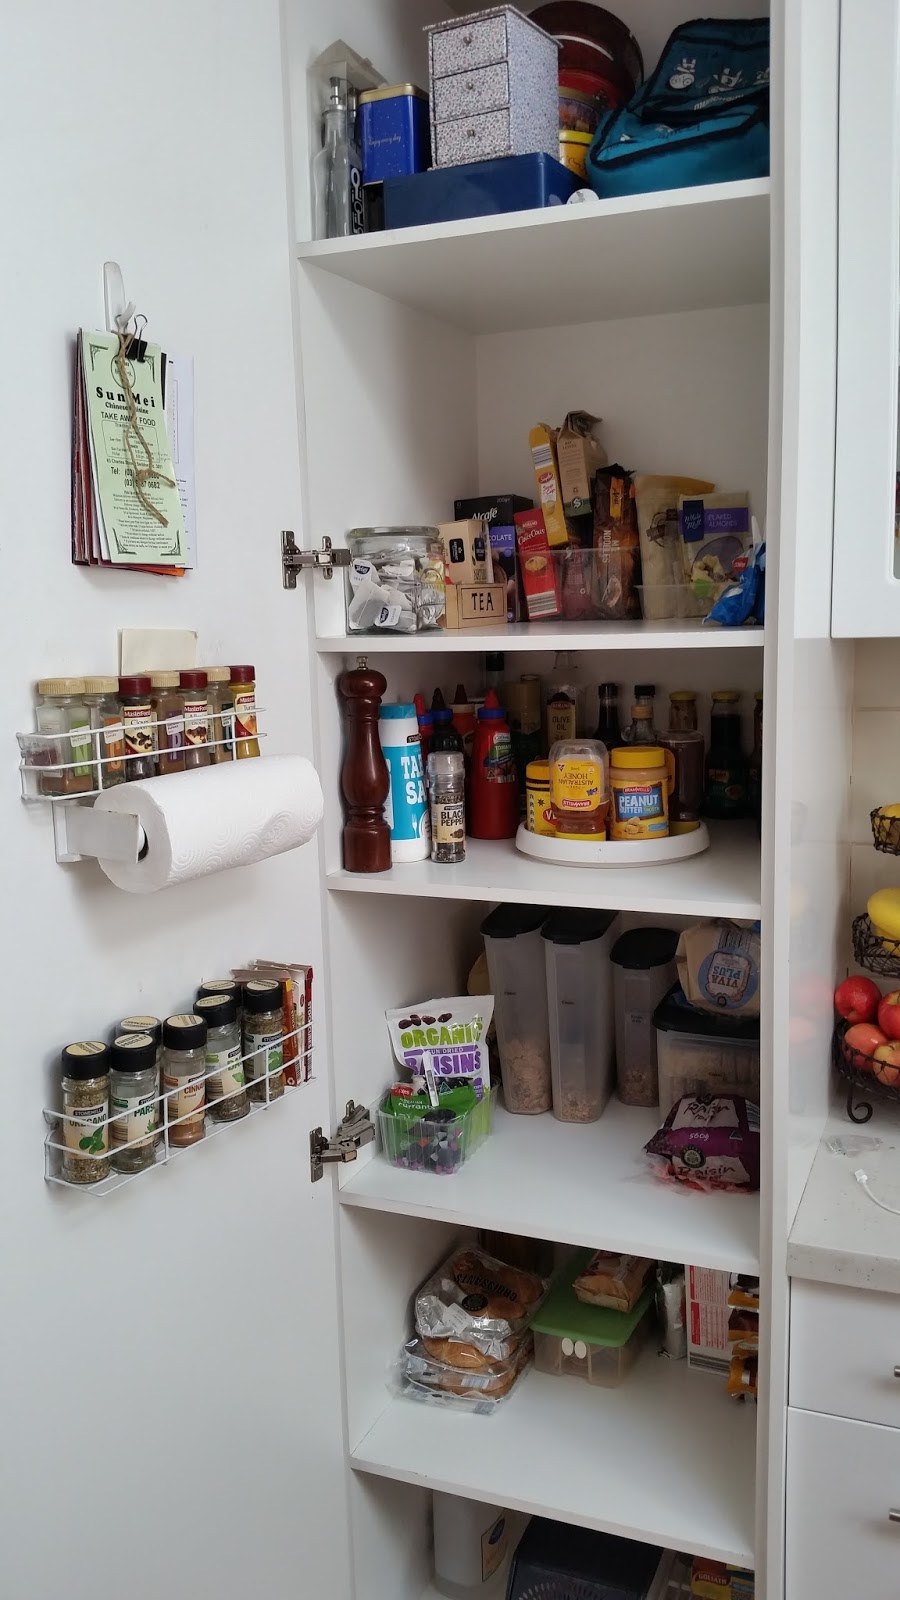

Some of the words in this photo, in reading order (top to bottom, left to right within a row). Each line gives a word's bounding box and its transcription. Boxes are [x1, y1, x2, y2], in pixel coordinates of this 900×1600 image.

[96, 386, 125, 402] Sun
[131, 393, 155, 407] Mei
[101, 411, 118, 421] TAKE
[139, 416, 156, 426] FOOD
[471, 592, 494, 611] TEA
[619, 795, 658, 807] PEANUT
[619, 806, 643, 814] BUTTER
[712, 965, 741, 979] PLUS
[711, 974, 738, 988] VIVA
[401, 1022, 483, 1049] ORGANIC
[698, 1573, 727, 1585] GOLIATH
